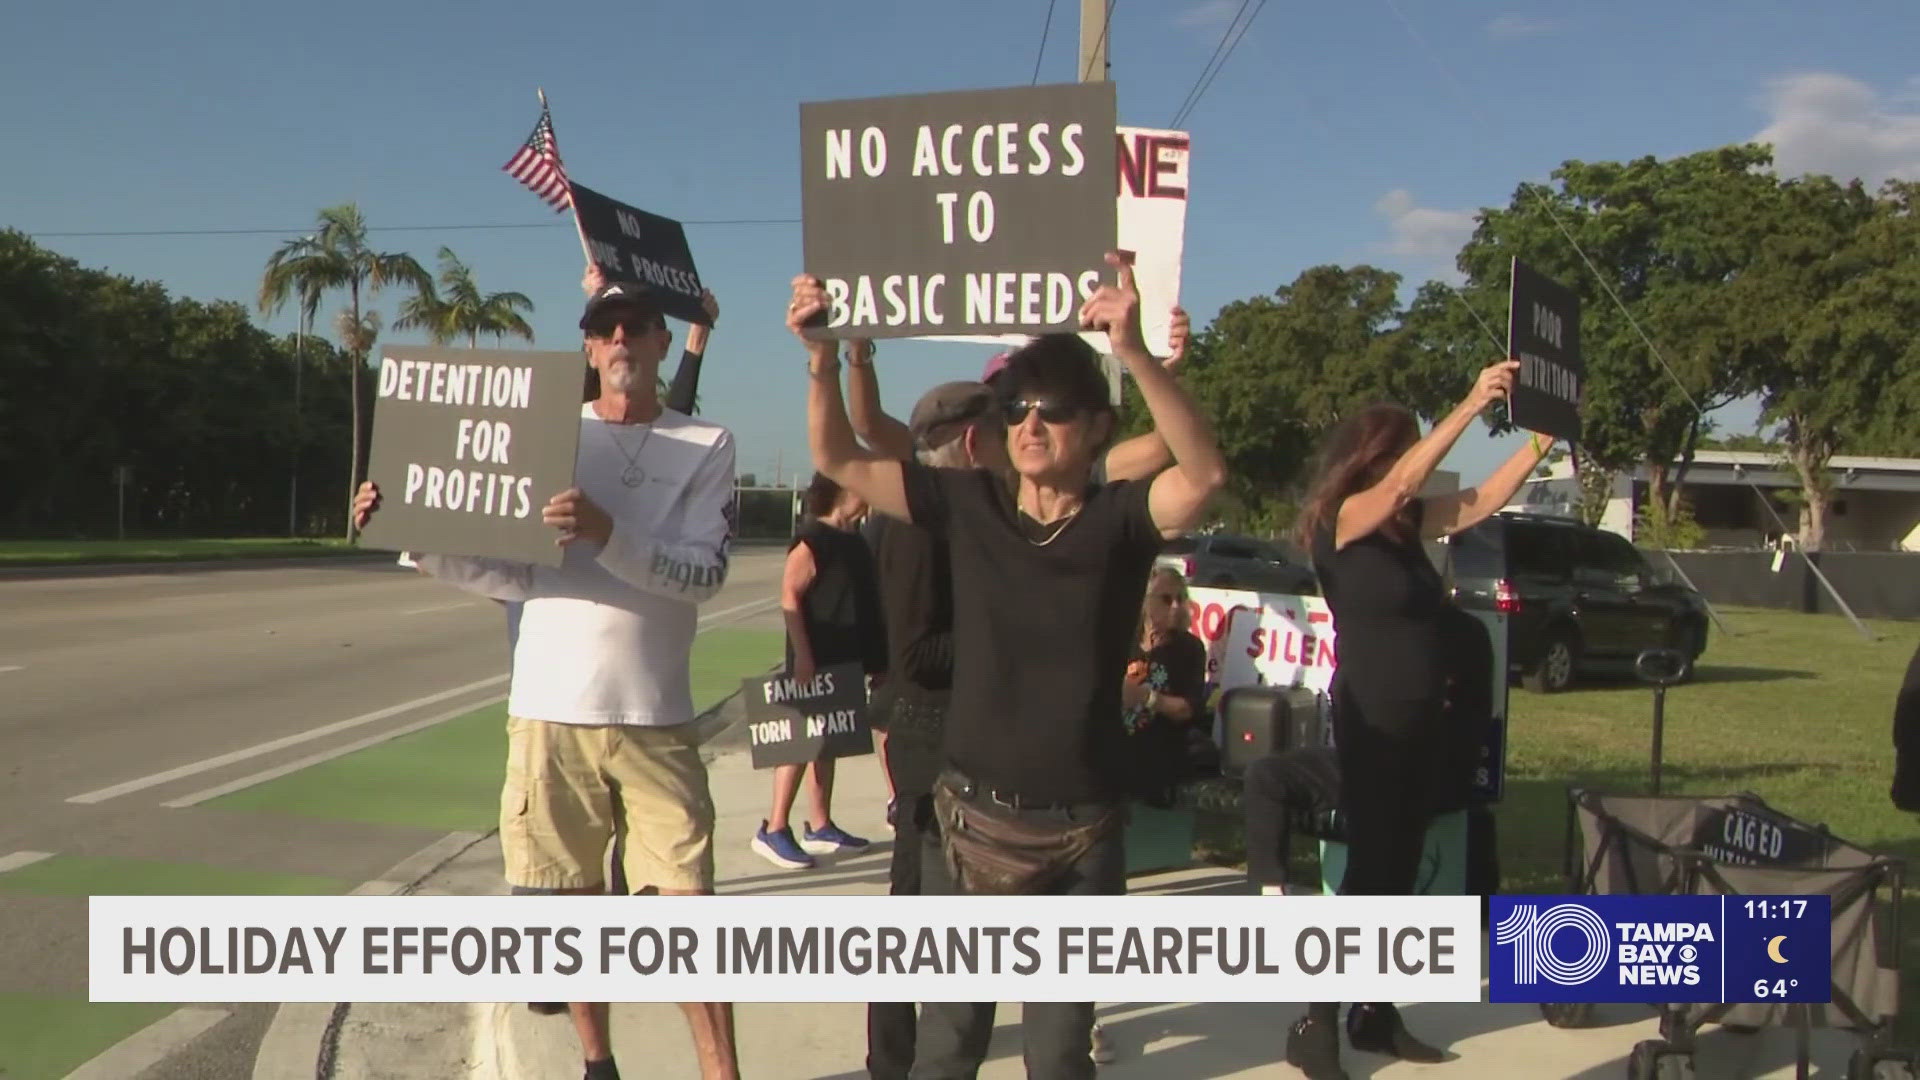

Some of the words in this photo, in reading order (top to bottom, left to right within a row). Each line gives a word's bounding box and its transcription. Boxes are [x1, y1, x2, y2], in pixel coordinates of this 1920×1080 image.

[826, 126, 888, 179] NO
[912, 123, 1085, 177] ACCESS
[616, 208, 641, 239] NO
[937, 190, 995, 244] TO
[631, 253, 701, 297] PROCESS
[826, 274, 945, 328] BASIC
[965, 271, 1099, 325] NEEDS
[1533, 301, 1562, 349] POOR
[379, 357, 533, 409] DETENTION
[456, 419, 512, 464] FOR
[405, 463, 532, 519] PROFITS
[1247, 627, 1337, 668] SILEN
[763, 673, 835, 704] FAMILIES
[748, 719, 792, 746] TORN
[806, 709, 856, 738] APART
[1723, 812, 1783, 859] CAGED
